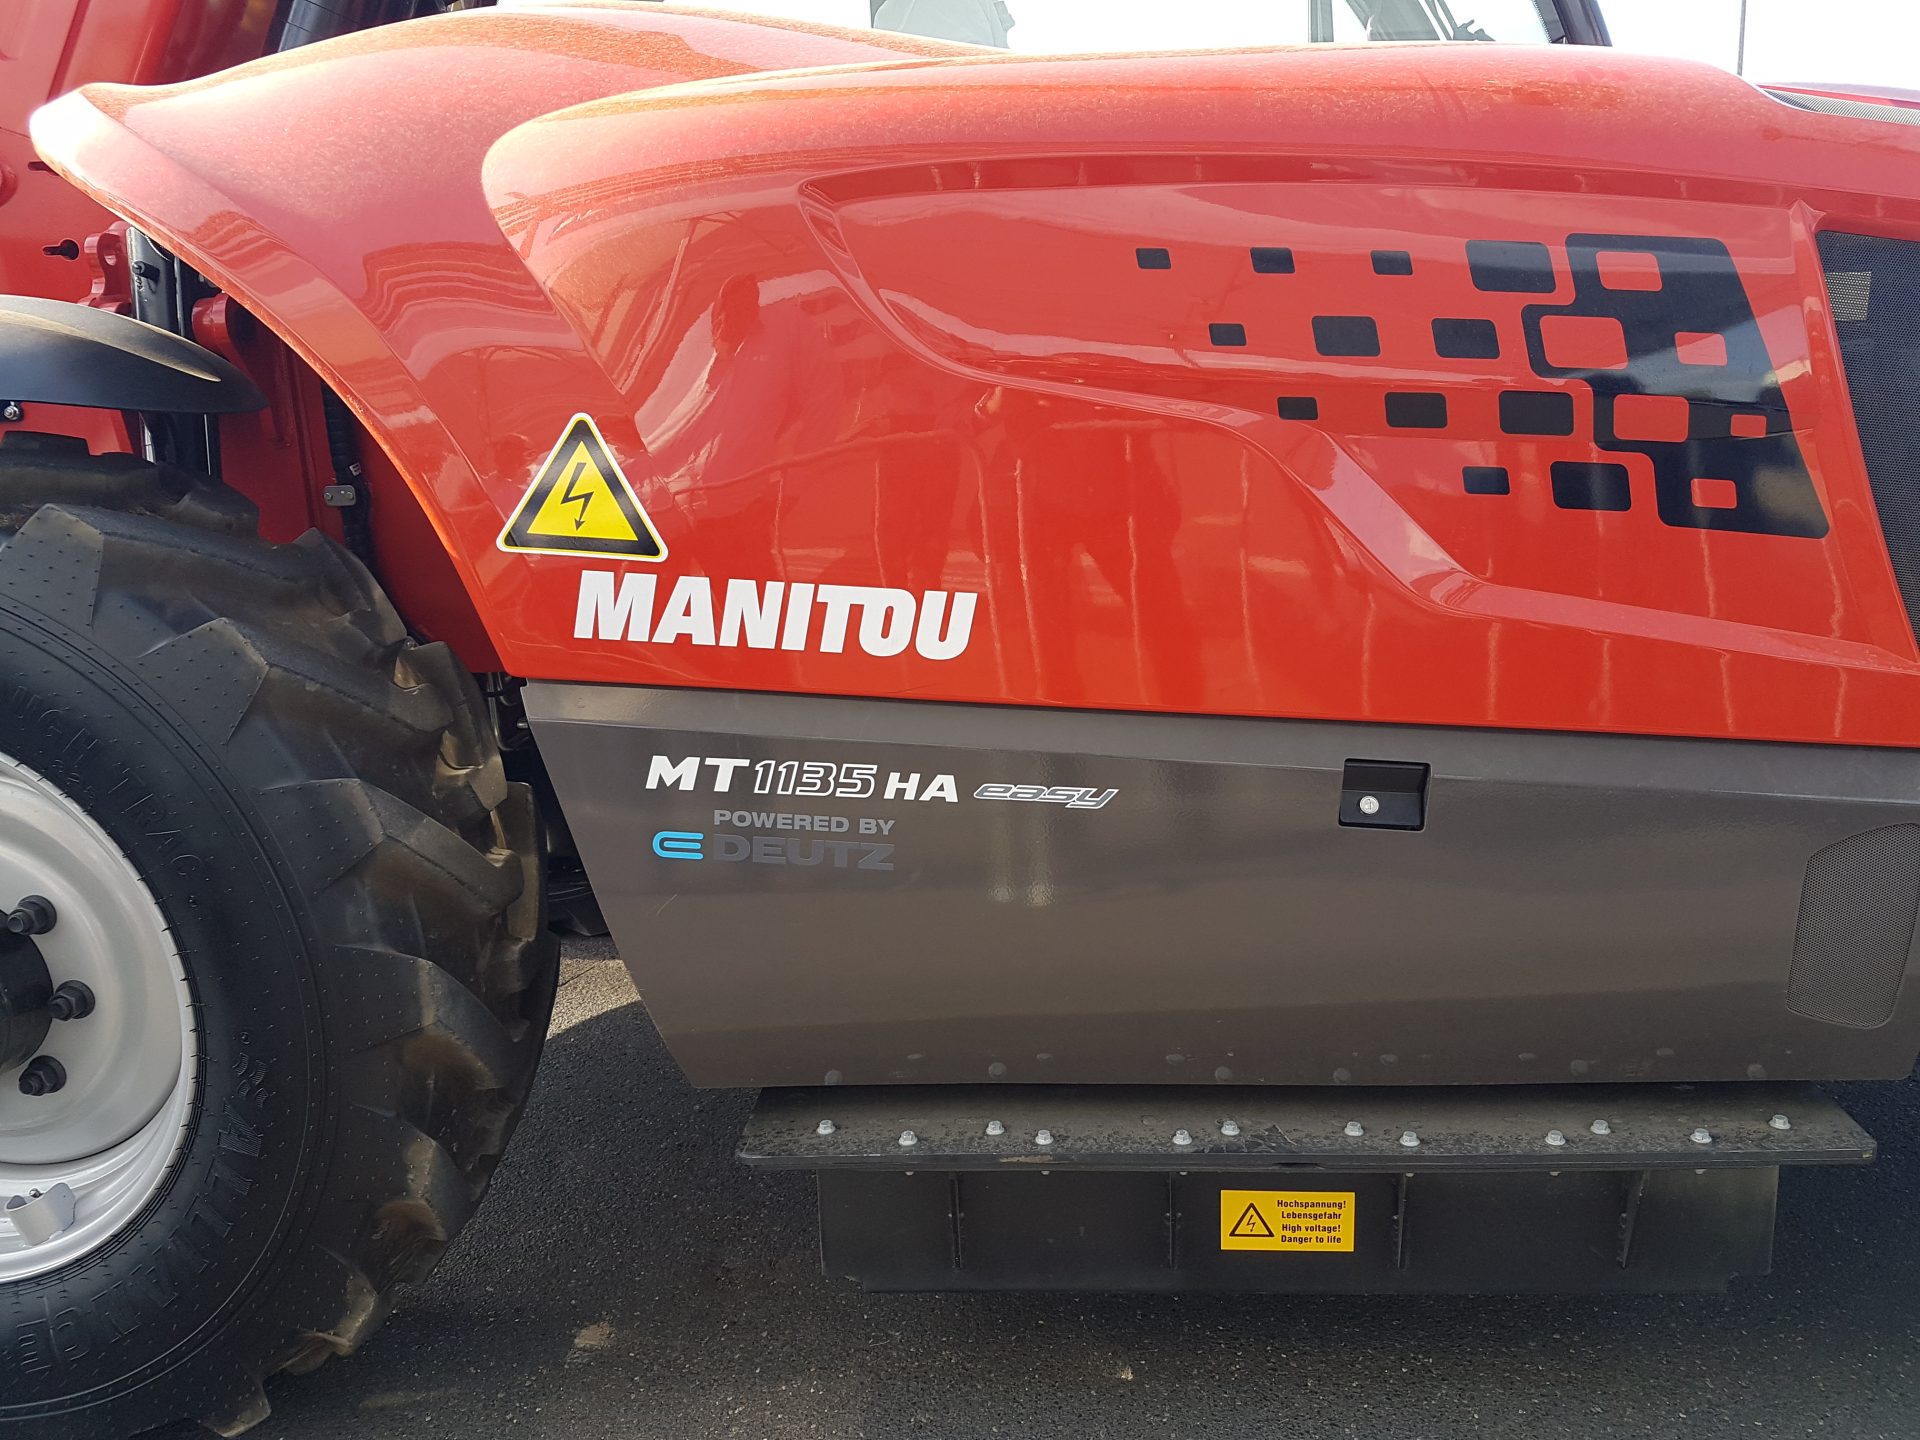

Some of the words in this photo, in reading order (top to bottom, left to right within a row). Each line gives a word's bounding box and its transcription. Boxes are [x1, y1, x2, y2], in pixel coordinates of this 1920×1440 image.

[573, 569, 978, 660] MANITOU
[645, 755, 750, 793] MT
[753, 759, 878, 799] 1135
[883, 772, 959, 803] HA
[973, 783, 1120, 810] easy
[713, 809, 850, 833] POWERED
[858, 818, 896, 836] BY
[713, 833, 896, 871] DEUTZ
[1277, 1199, 1347, 1210] Hochspannung!
[1281, 1211, 1342, 1221] Lebensgefahr
[1281, 1223, 1302, 1234] High
[1304, 1224, 1341, 1234] voltage!
[1280, 1235, 1313, 1244] Danger
[1315, 1235, 1325, 1244] to
[1326, 1235, 1342, 1244] life
